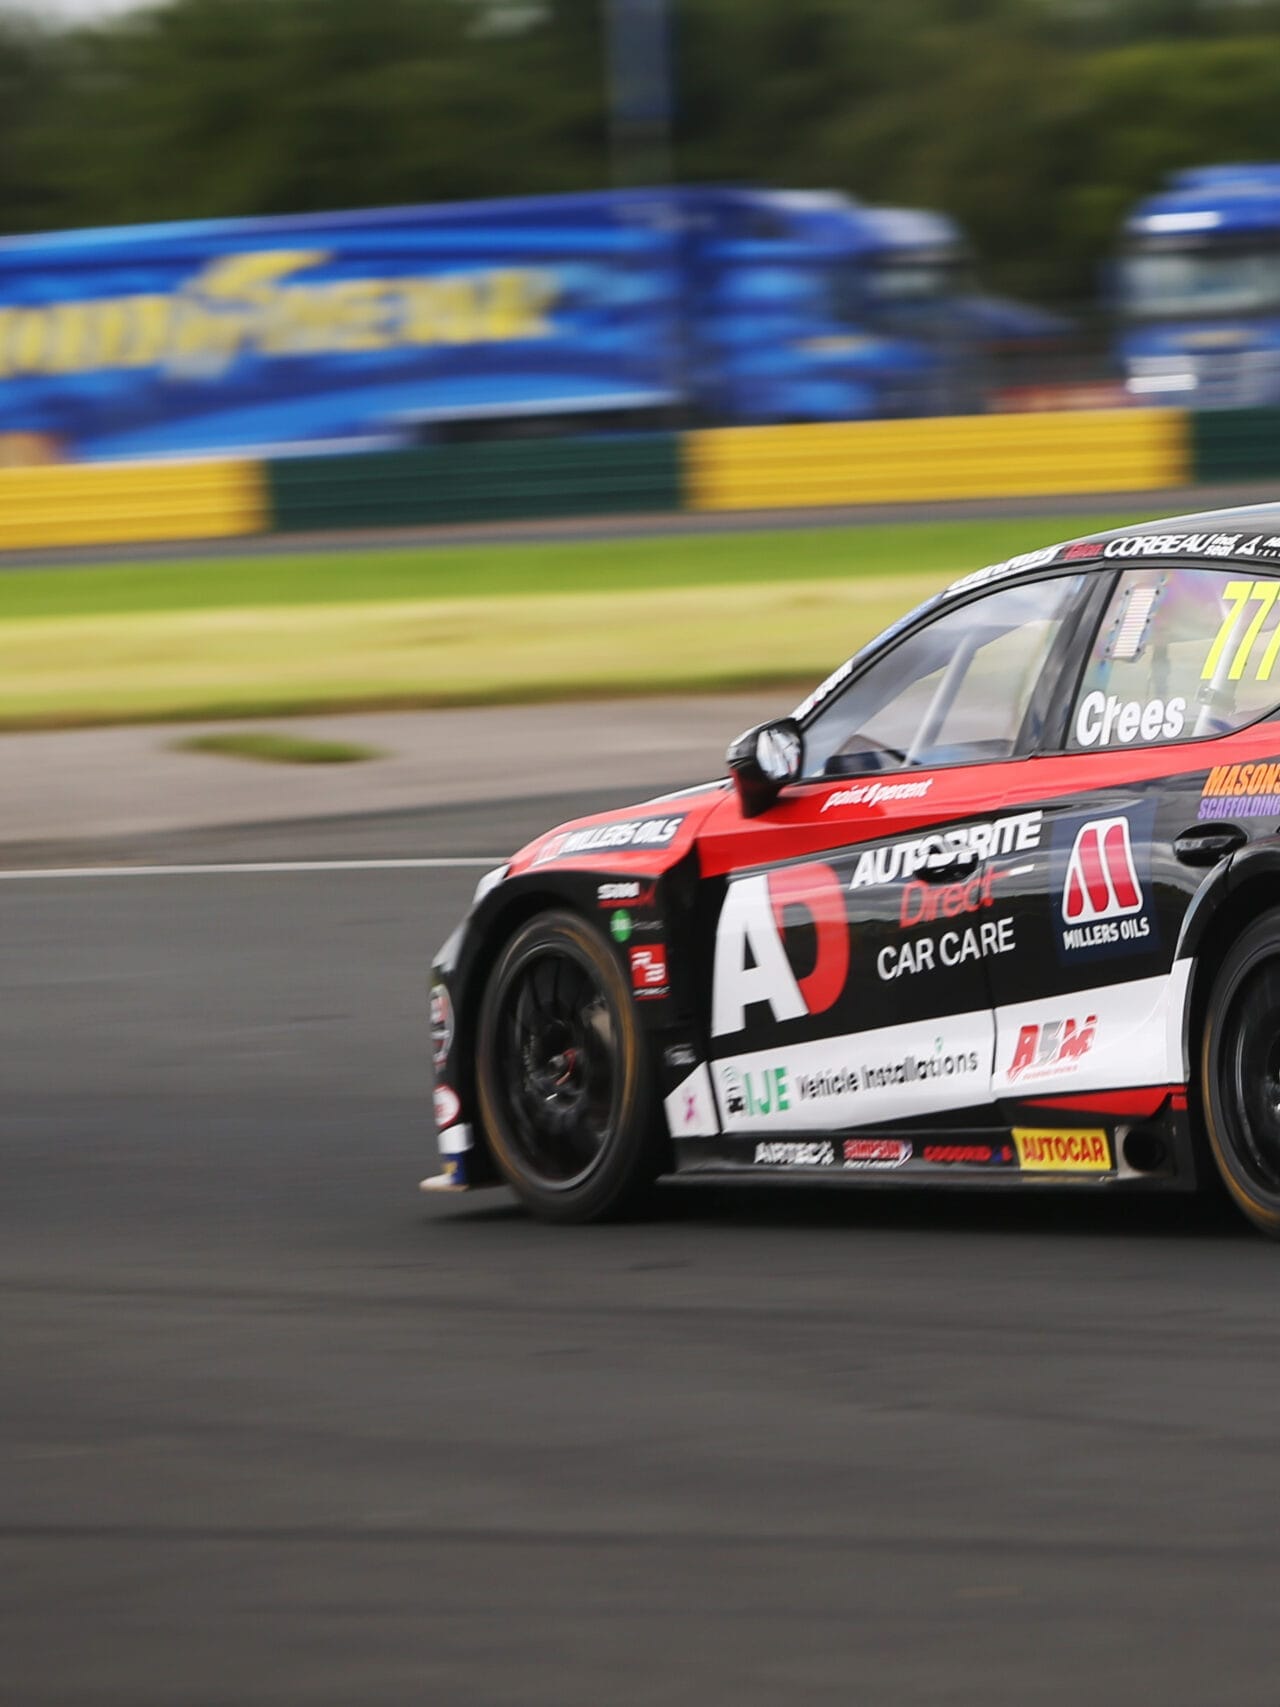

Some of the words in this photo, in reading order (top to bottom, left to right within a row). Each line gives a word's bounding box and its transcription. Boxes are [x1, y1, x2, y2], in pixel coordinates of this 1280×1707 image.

[1103, 533, 1218, 557] CORBEAU
[1076, 690, 1187, 747] Crees
[850, 810, 1043, 890] AUTOBRITE
[899, 864, 1002, 929] Direct
[876, 938, 935, 981] CAR
[939, 917, 1016, 966] CARE
[1062, 922, 1120, 950] MILLERS
[1120, 917, 1151, 940] OILS
[797, 1070, 858, 1101] Vehicle
[1021, 1135, 1106, 1162] AUTOCAR
